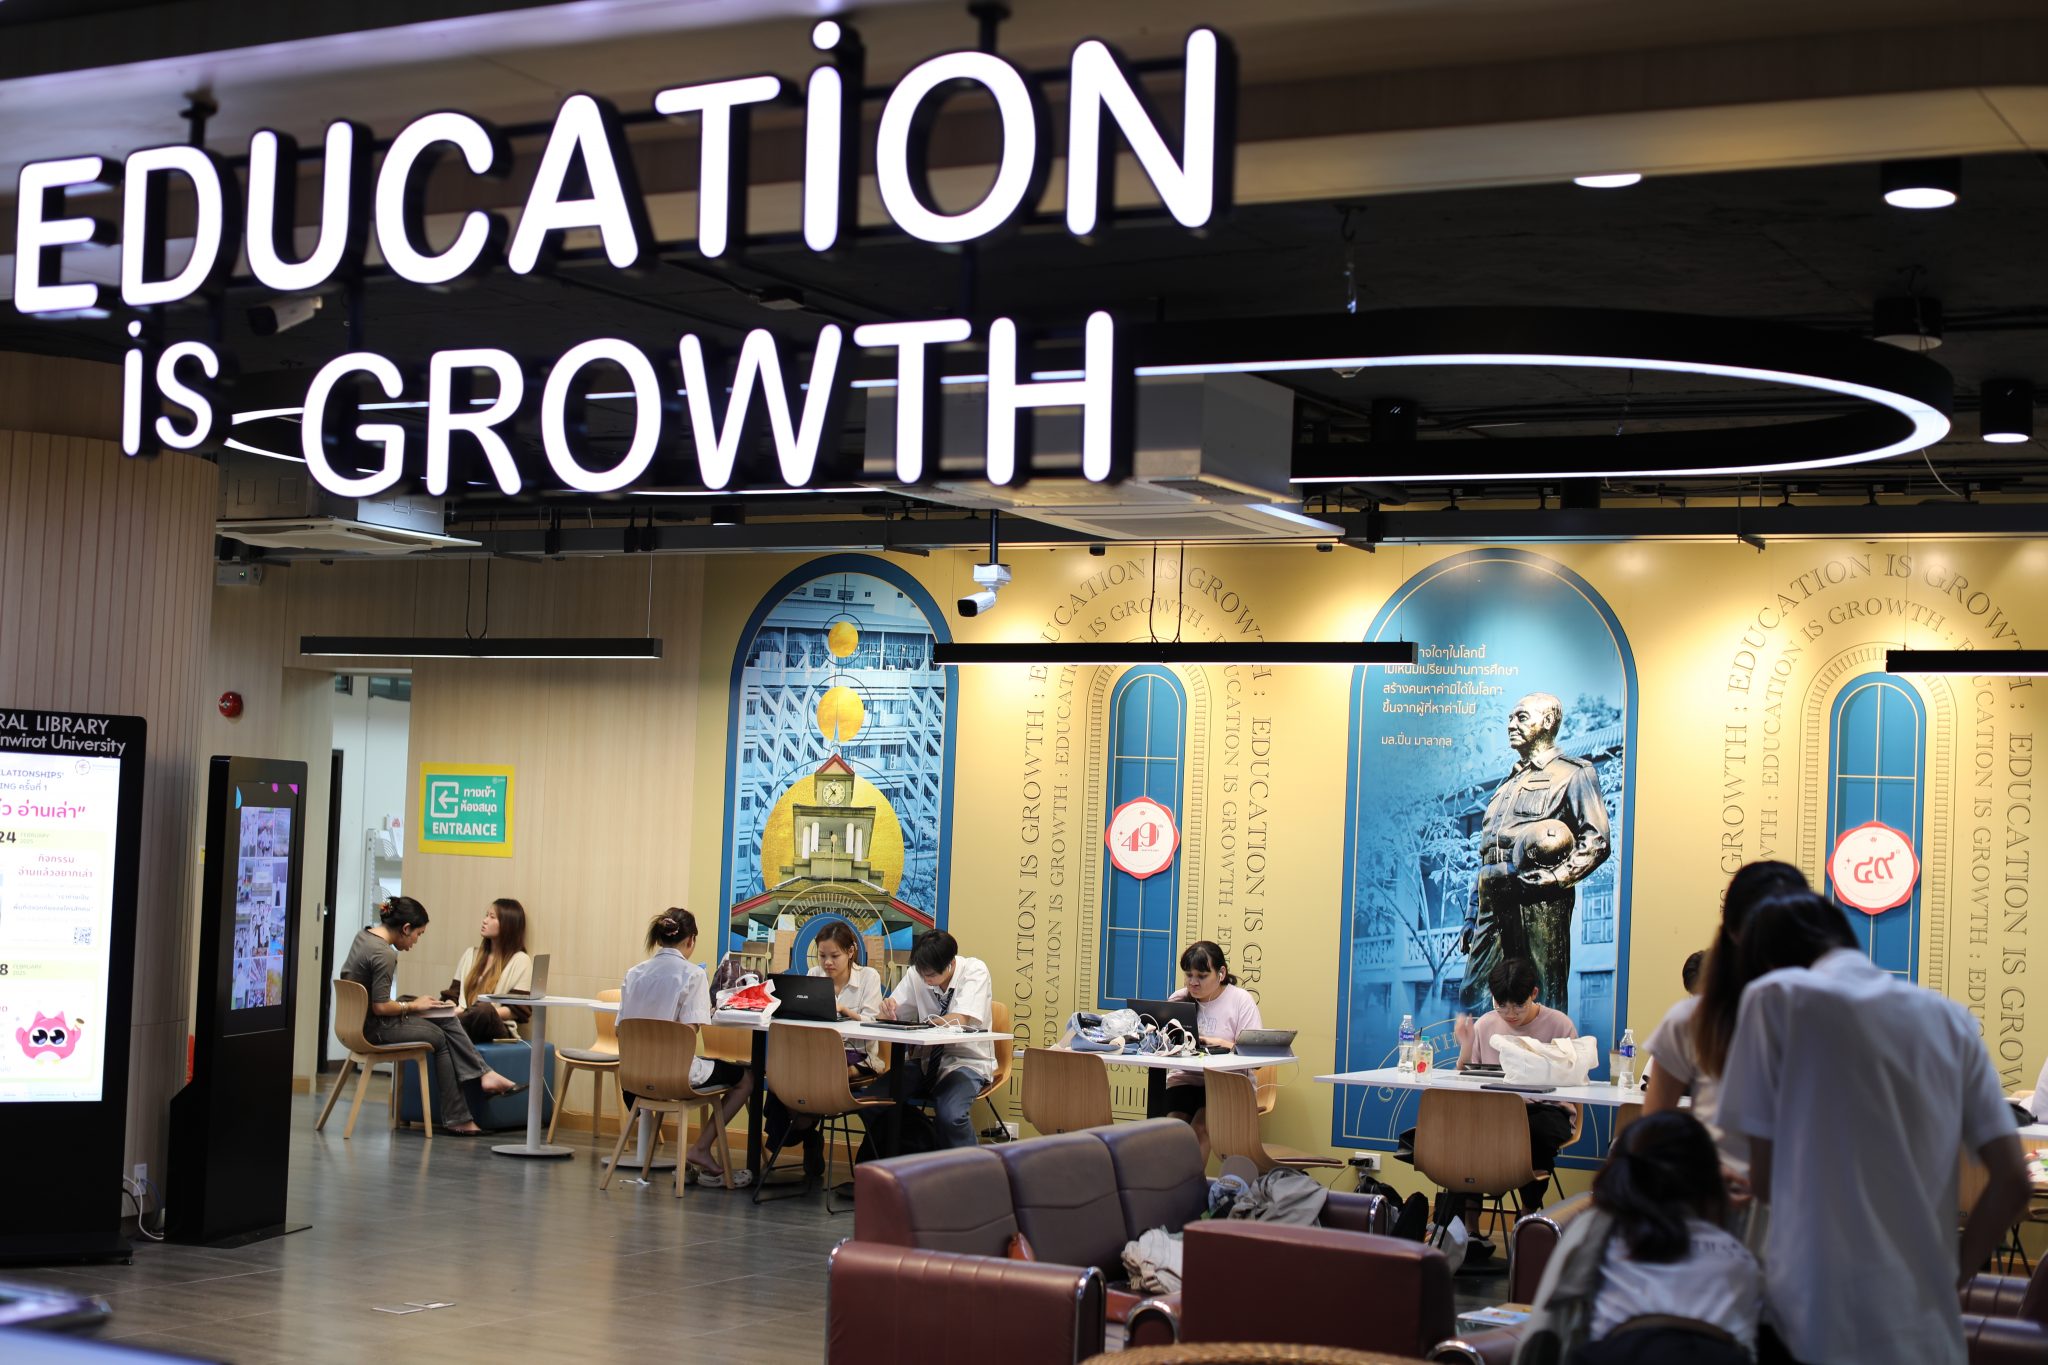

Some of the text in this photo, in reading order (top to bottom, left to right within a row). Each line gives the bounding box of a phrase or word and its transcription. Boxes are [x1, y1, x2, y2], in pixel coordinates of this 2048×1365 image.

[301, 311, 1114, 498] GROWTH
[1155, 558, 1178, 580] IS
[1884, 553, 1912, 578] IS
[1110, 597, 1204, 628] GROWTH
[1728, 553, 1872, 695] EDUCATION
[1827, 597, 1946, 633] GROWTH
[1088, 616, 1107, 637] IS
[1800, 619, 1824, 643] IS
[36, 715, 110, 735] LIBRARY
[1762, 640, 1803, 787] EDUCATION
[0, 733, 126, 756] nwirot University
[1021, 709, 1045, 844] GROWTH
[1223, 774, 1238, 793] IS
[463, 785, 496, 798] ทางเข้า
[1720, 724, 1747, 876] GROWTH
[460, 799, 497, 816] ห้องสมุด
[1246, 717, 1271, 896] EDUCATION
[1973, 797, 1992, 818] IS
[432, 822, 497, 836] ENTRANCE
[1050, 785, 1068, 887] GROWTH
[1121, 822, 1159, 851] 49
[2003, 732, 2032, 935] EDUCATION
[1020, 854, 1038, 878] IS
[1218, 801, 1237, 905] GROWTH
[1969, 827, 1992, 944] GROWTH
[1048, 894, 1063, 912] IS
[1243, 907, 1264, 932] IS
[2002, 947, 2027, 975] IS
